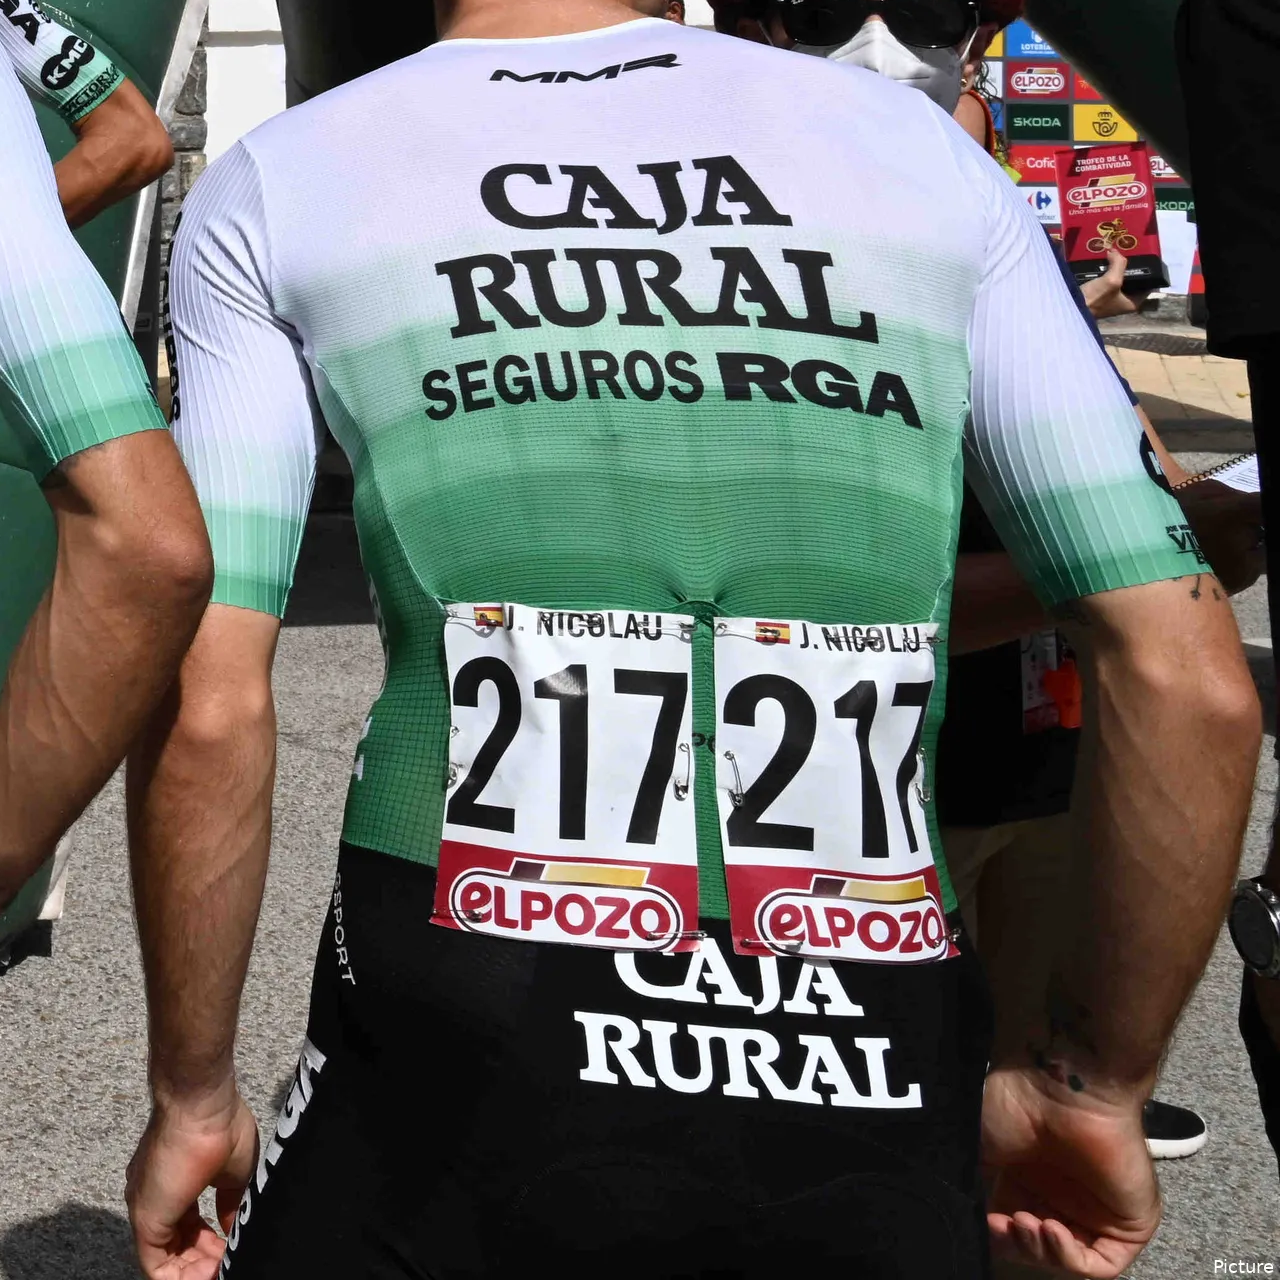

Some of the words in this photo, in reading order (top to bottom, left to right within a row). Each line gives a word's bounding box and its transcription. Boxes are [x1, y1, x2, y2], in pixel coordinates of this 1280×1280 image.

[45, 38, 89, 86] KMC
[489, 53, 683, 84] MMR
[1021, 42, 1054, 50] LOTERÍA
[1026, 157, 1056, 168] Cofi
[1075, 160, 1132, 173] COMBATIVIDAD
[1076, 157, 1105, 166] TROFEO
[479, 155, 793, 234] CAJA
[435, 246, 879, 345] RURAL
[421, 349, 704, 421] SEGUROS
[715, 351, 924, 431] RGA
[506, 606, 525, 631] J.
[537, 610, 662, 641] NICOLAU
[800, 622, 819, 650] J.
[445, 656, 688, 844] 217
[723, 673, 933, 859] 217
[612, 937, 864, 1017] CAJA
[573, 1010, 923, 1108] RURAL
